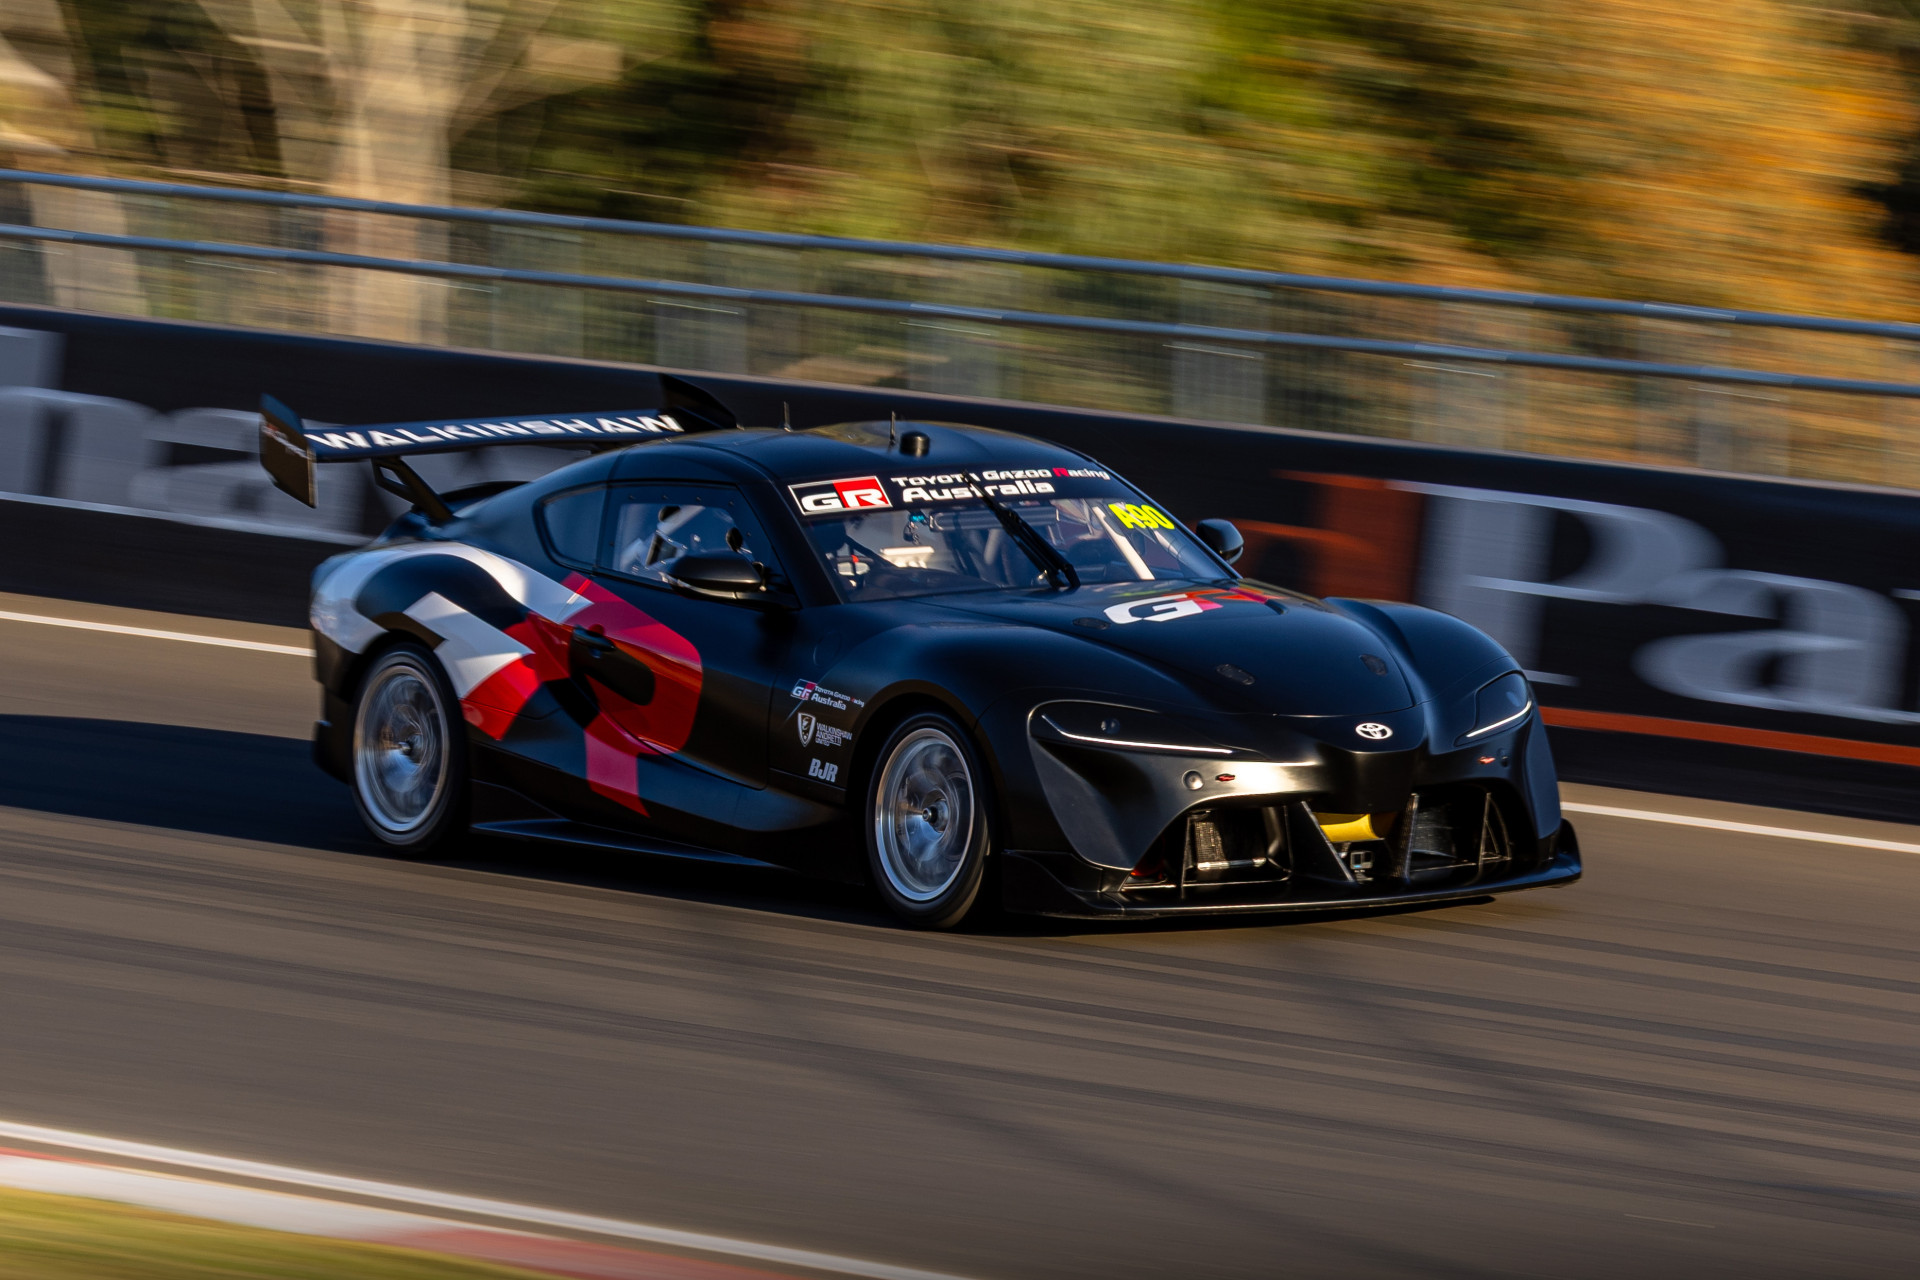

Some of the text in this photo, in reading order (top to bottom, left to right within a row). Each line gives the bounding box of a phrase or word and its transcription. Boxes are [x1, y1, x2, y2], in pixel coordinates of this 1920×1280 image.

[304, 414, 683, 450] WALKINSHAW
[982, 469, 1052, 481] GAZOO
[801, 488, 890, 511] GR
[902, 480, 1056, 503] Australia
[1108, 503, 1175, 530] A90
[811, 693, 846, 710] Australia
[808, 758, 838, 782] BJR
